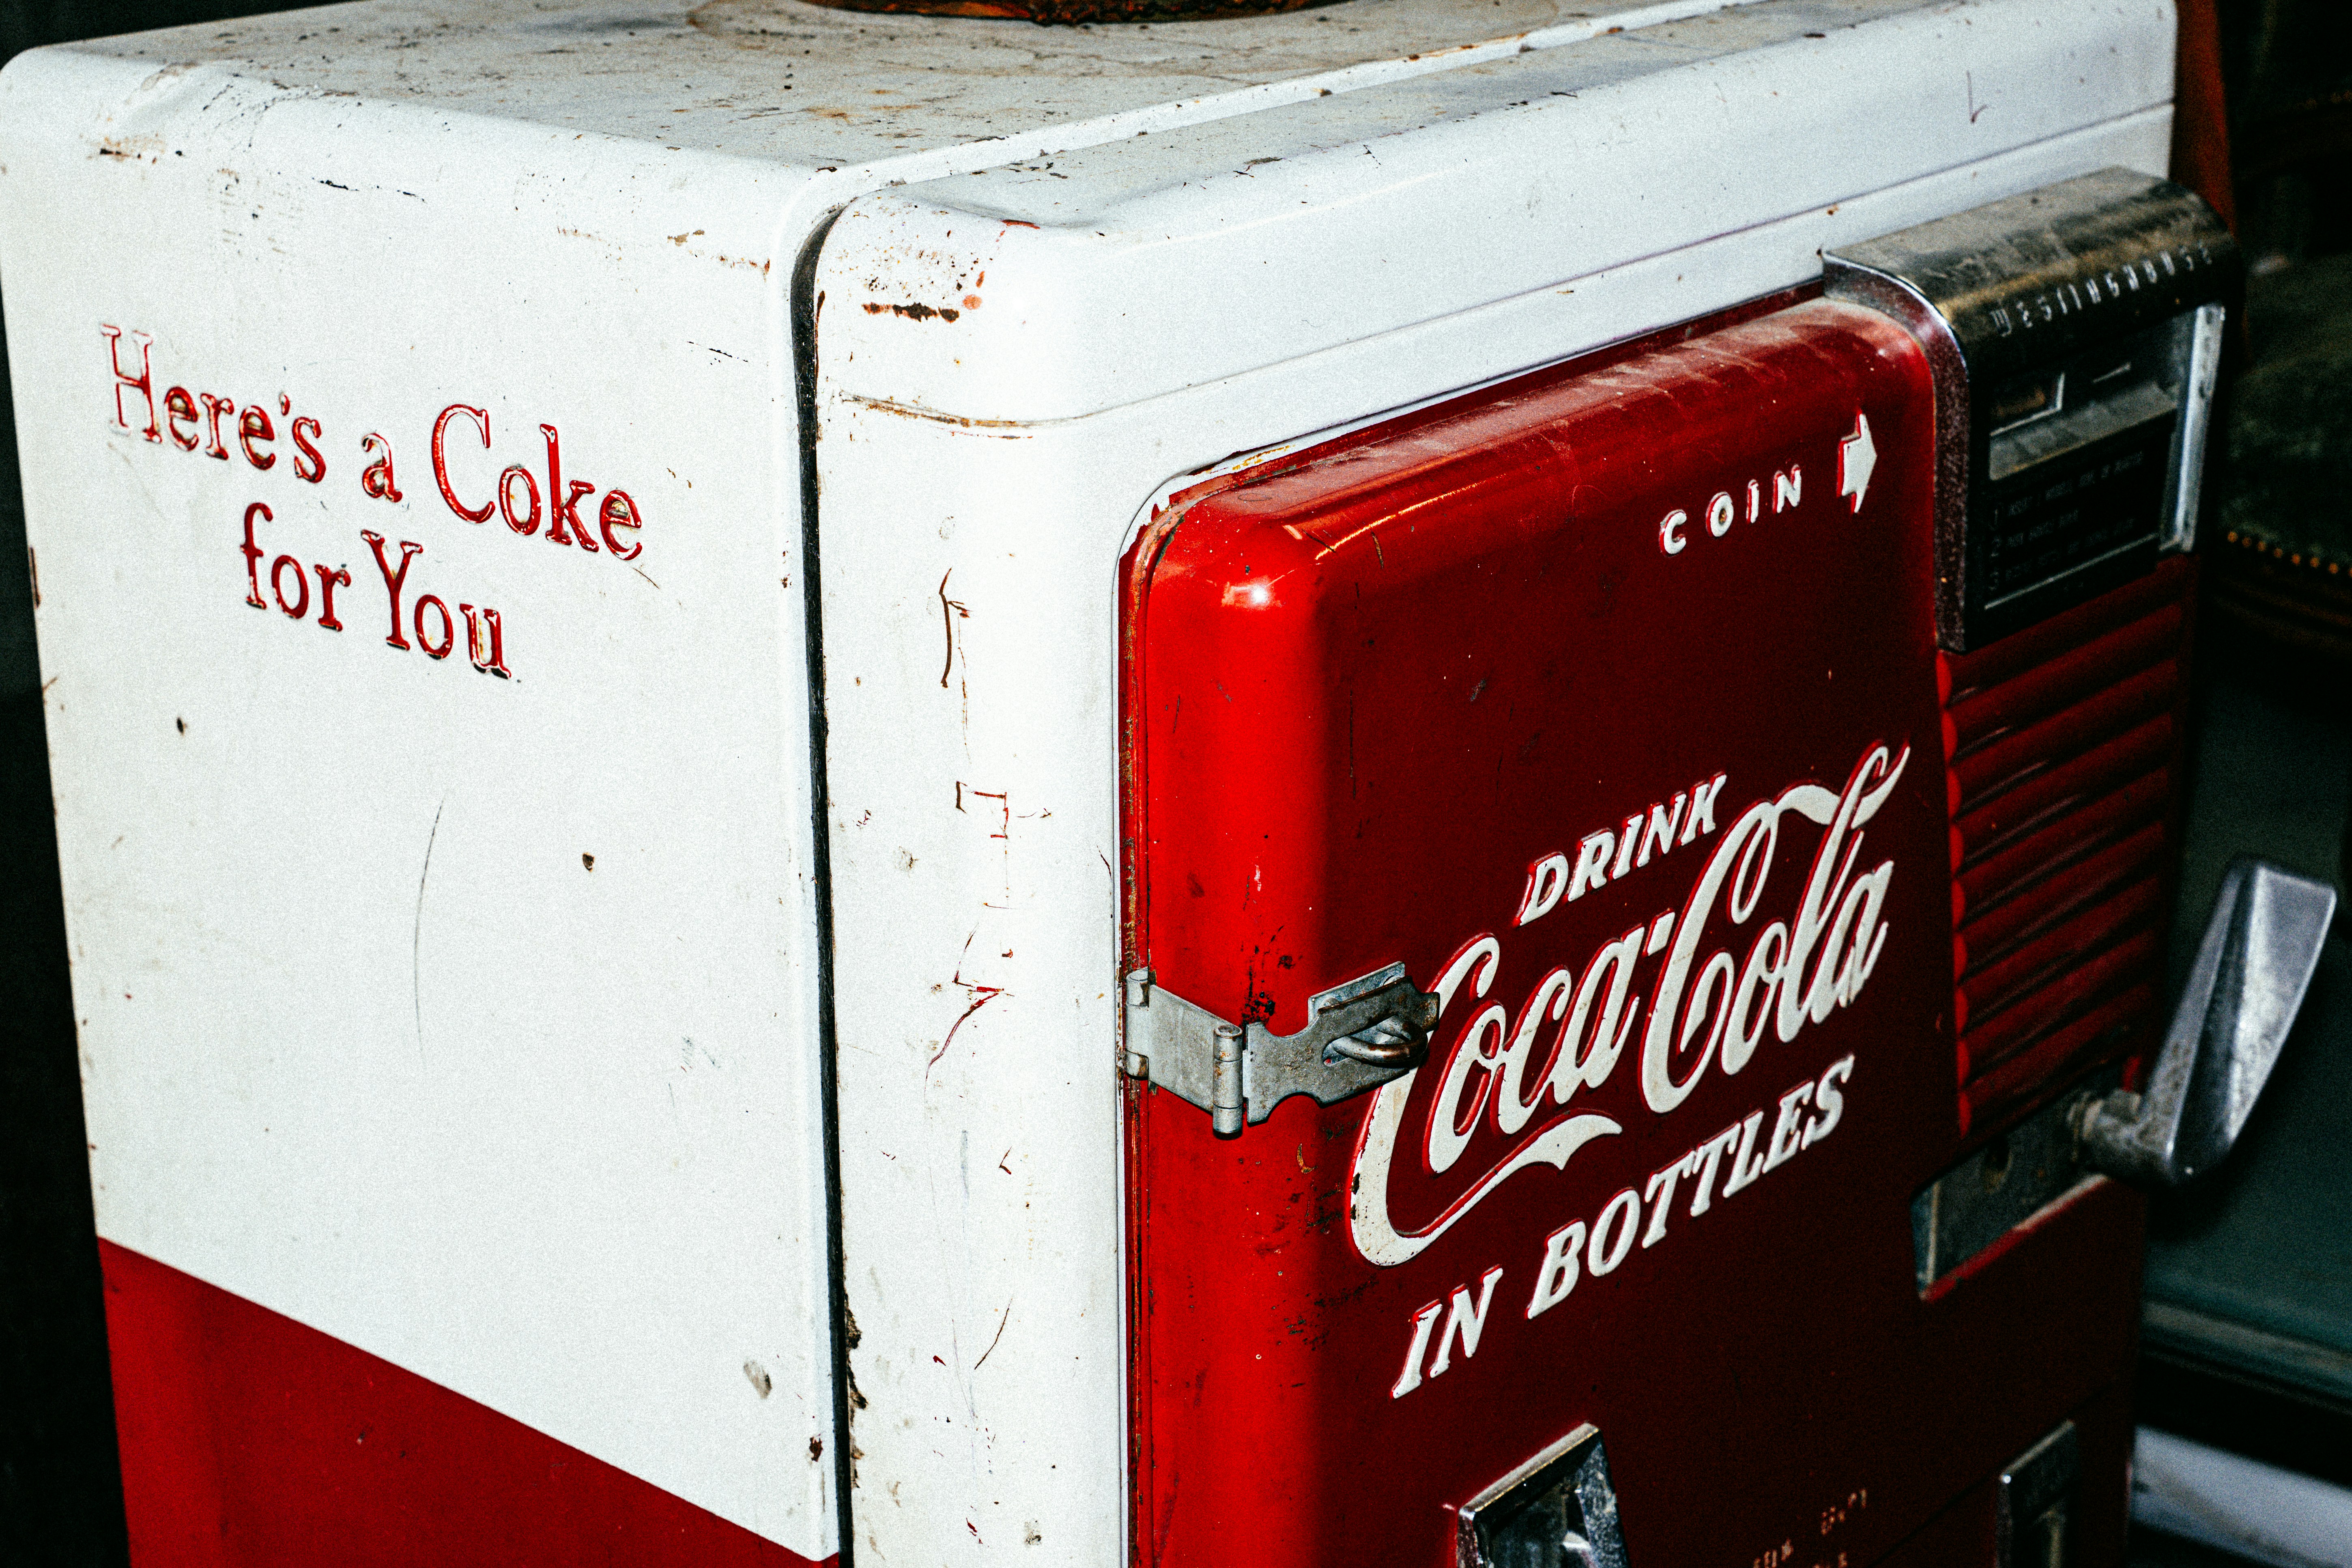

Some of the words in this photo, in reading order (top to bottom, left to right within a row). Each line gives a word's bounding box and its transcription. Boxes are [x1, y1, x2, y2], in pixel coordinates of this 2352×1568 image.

[101, 325, 326, 483] Here's
[361, 432, 403, 503] a
[431, 404, 643, 561] Coke
[1660, 465, 1802, 555] COIN
[240, 502, 351, 631] for
[360, 529, 512, 680] You
[1515, 772, 1727, 927] DRINK
[1350, 741, 1911, 1267] Coca-Cola
[1391, 1265, 1503, 1399] IN
[1526, 1054, 1854, 1318] BOTTLES
